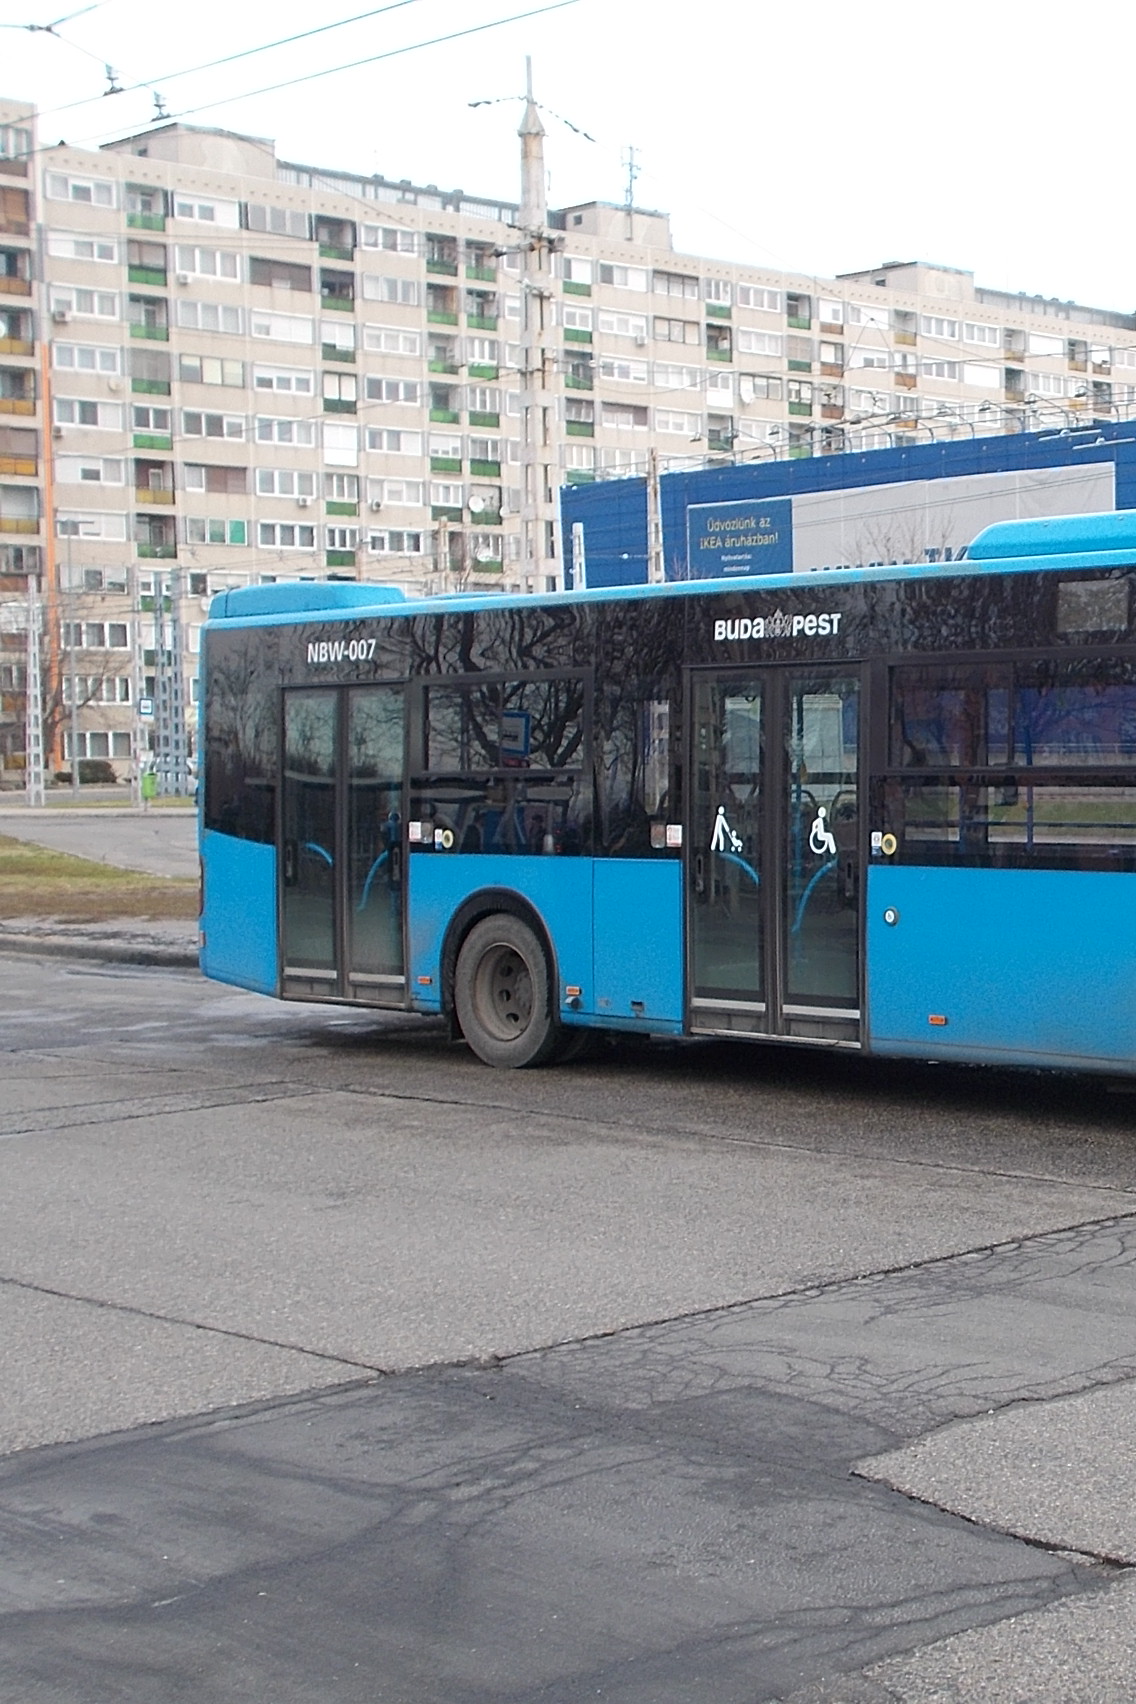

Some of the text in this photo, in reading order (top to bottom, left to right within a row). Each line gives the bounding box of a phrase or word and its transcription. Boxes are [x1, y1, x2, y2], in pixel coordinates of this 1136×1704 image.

[759, 517, 771, 528] az
[700, 532, 779, 549] IKEA áruházban!
[307, 638, 376, 663] NBW-007
